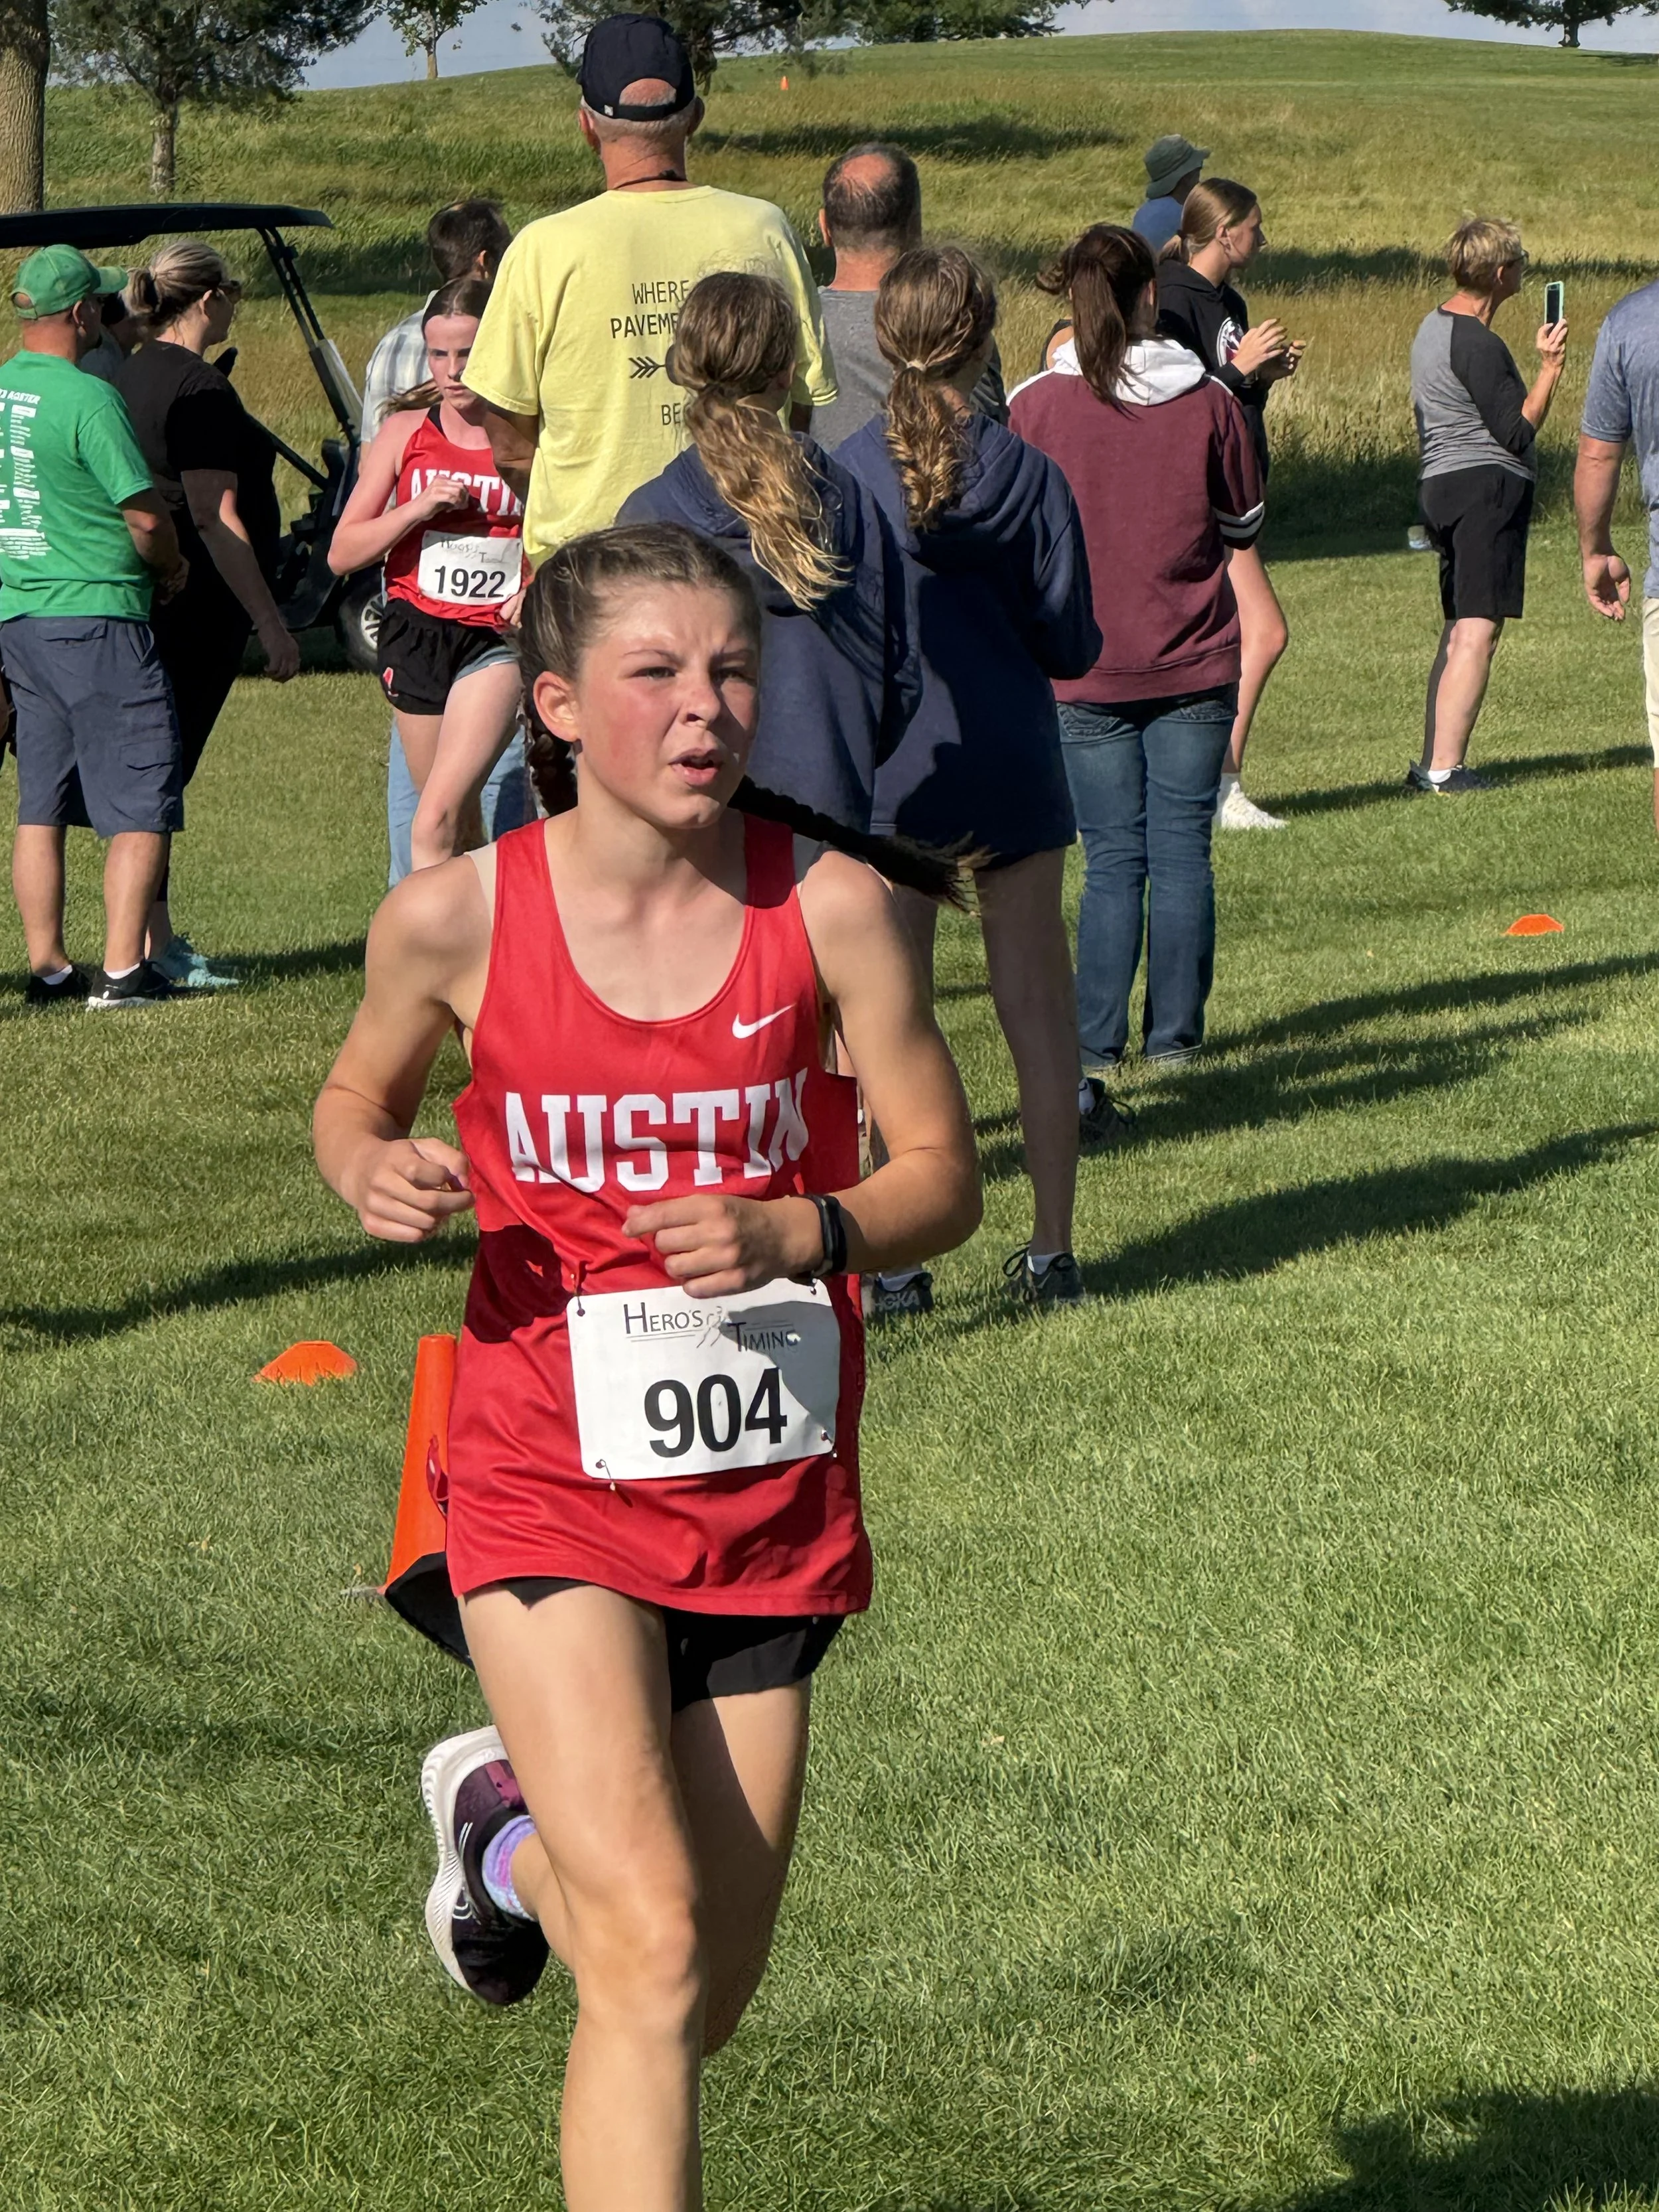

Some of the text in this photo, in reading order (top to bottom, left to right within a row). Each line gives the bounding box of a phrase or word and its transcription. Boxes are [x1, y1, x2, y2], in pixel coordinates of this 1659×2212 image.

[631, 279, 689, 305] WHERE
[434, 565, 506, 598] 1922
[505, 1067, 810, 1193] AUSTIN
[622, 1301, 703, 1335] HERO'S
[644, 1366, 788, 1458] 904
